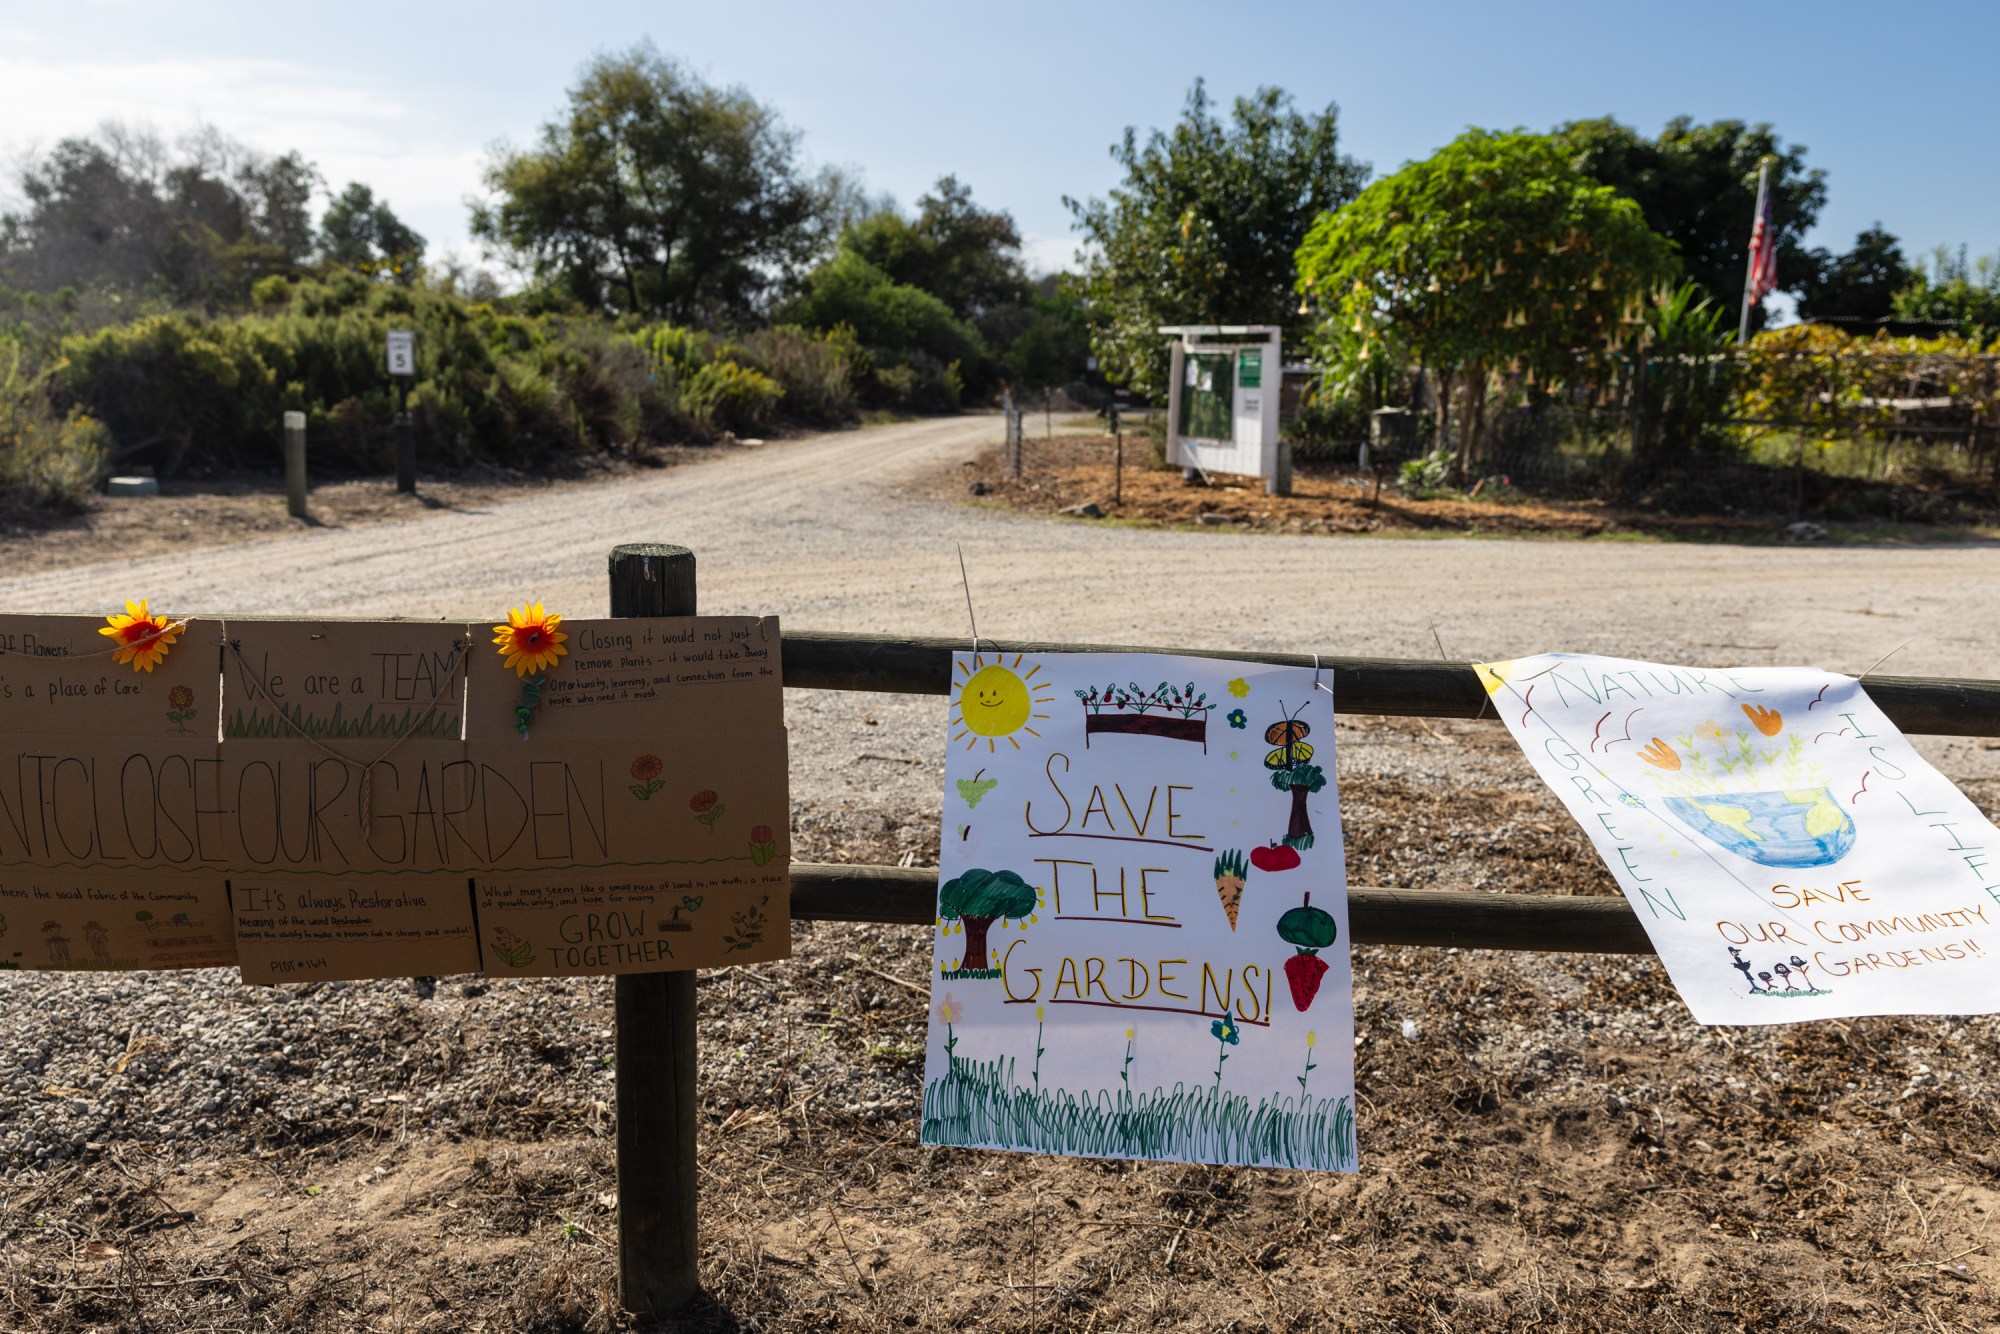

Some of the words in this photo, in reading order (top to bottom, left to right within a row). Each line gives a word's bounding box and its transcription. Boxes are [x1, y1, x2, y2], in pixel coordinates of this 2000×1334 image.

[395, 353, 407, 369] 5
[579, 629, 633, 651] Closing
[643, 628, 654, 645] it
[662, 628, 694, 645] would
[704, 628, 721, 642] not
[729, 626, 752, 642] just
[574, 658, 613, 671] remove
[669, 653, 678, 664] it
[684, 649, 713, 662] would
[719, 649, 739, 661] take
[745, 648, 768, 660] away
[239, 652, 284, 700] We
[304, 675, 340, 695] are
[351, 677, 364, 694] a
[371, 651, 454, 700] TEAM
[653, 674, 670, 684] and
[732, 669, 753, 679] from
[759, 667, 773, 677] the
[1549, 665, 1765, 708] NATURE
[25, 685, 35, 698] a
[48, 677, 88, 704] place
[95, 677, 107, 694] of
[577, 693, 594, 703] who
[596, 692, 616, 701] need
[621, 690, 628, 699] it
[1838, 713, 1906, 780] IS
[1026, 753, 1206, 839] SAVE
[358, 760, 608, 864] GARDEN
[1545, 738, 1686, 921] GREEN
[32, 885, 52, 899] the
[55, 887, 83, 900] social
[120, 890, 129, 900] of
[133, 891, 146, 900] the
[239, 888, 286, 912] It's
[297, 888, 346, 913] always
[348, 889, 427, 910] Restorative
[481, 899, 492, 908] of
[559, 896, 578, 905] and
[583, 894, 603, 904] hope
[608, 894, 624, 902] for
[482, 885, 512, 897] What
[520, 887, 542, 899] may
[580, 884, 595, 893] like
[608, 883, 631, 892] small
[659, 881, 669, 889] of
[673, 880, 693, 889] land
[1034, 859, 1176, 920] THE
[1771, 880, 1870, 909] SAVE
[264, 931, 277, 939] the
[304, 930, 312, 938] to
[396, 929, 421, 938] strong
[424, 928, 440, 936] and
[278, 916, 289, 925] of
[291, 916, 306, 925] the
[308, 915, 329, 925] word
[559, 909, 644, 944] GROW
[1717, 920, 1807, 946] OUR
[1814, 904, 1990, 944] COMMUNITY
[545, 939, 674, 969] TOGETHER
[1814, 938, 1987, 977] GARDENS!!
[1001, 939, 1272, 1023] GARDENS!
